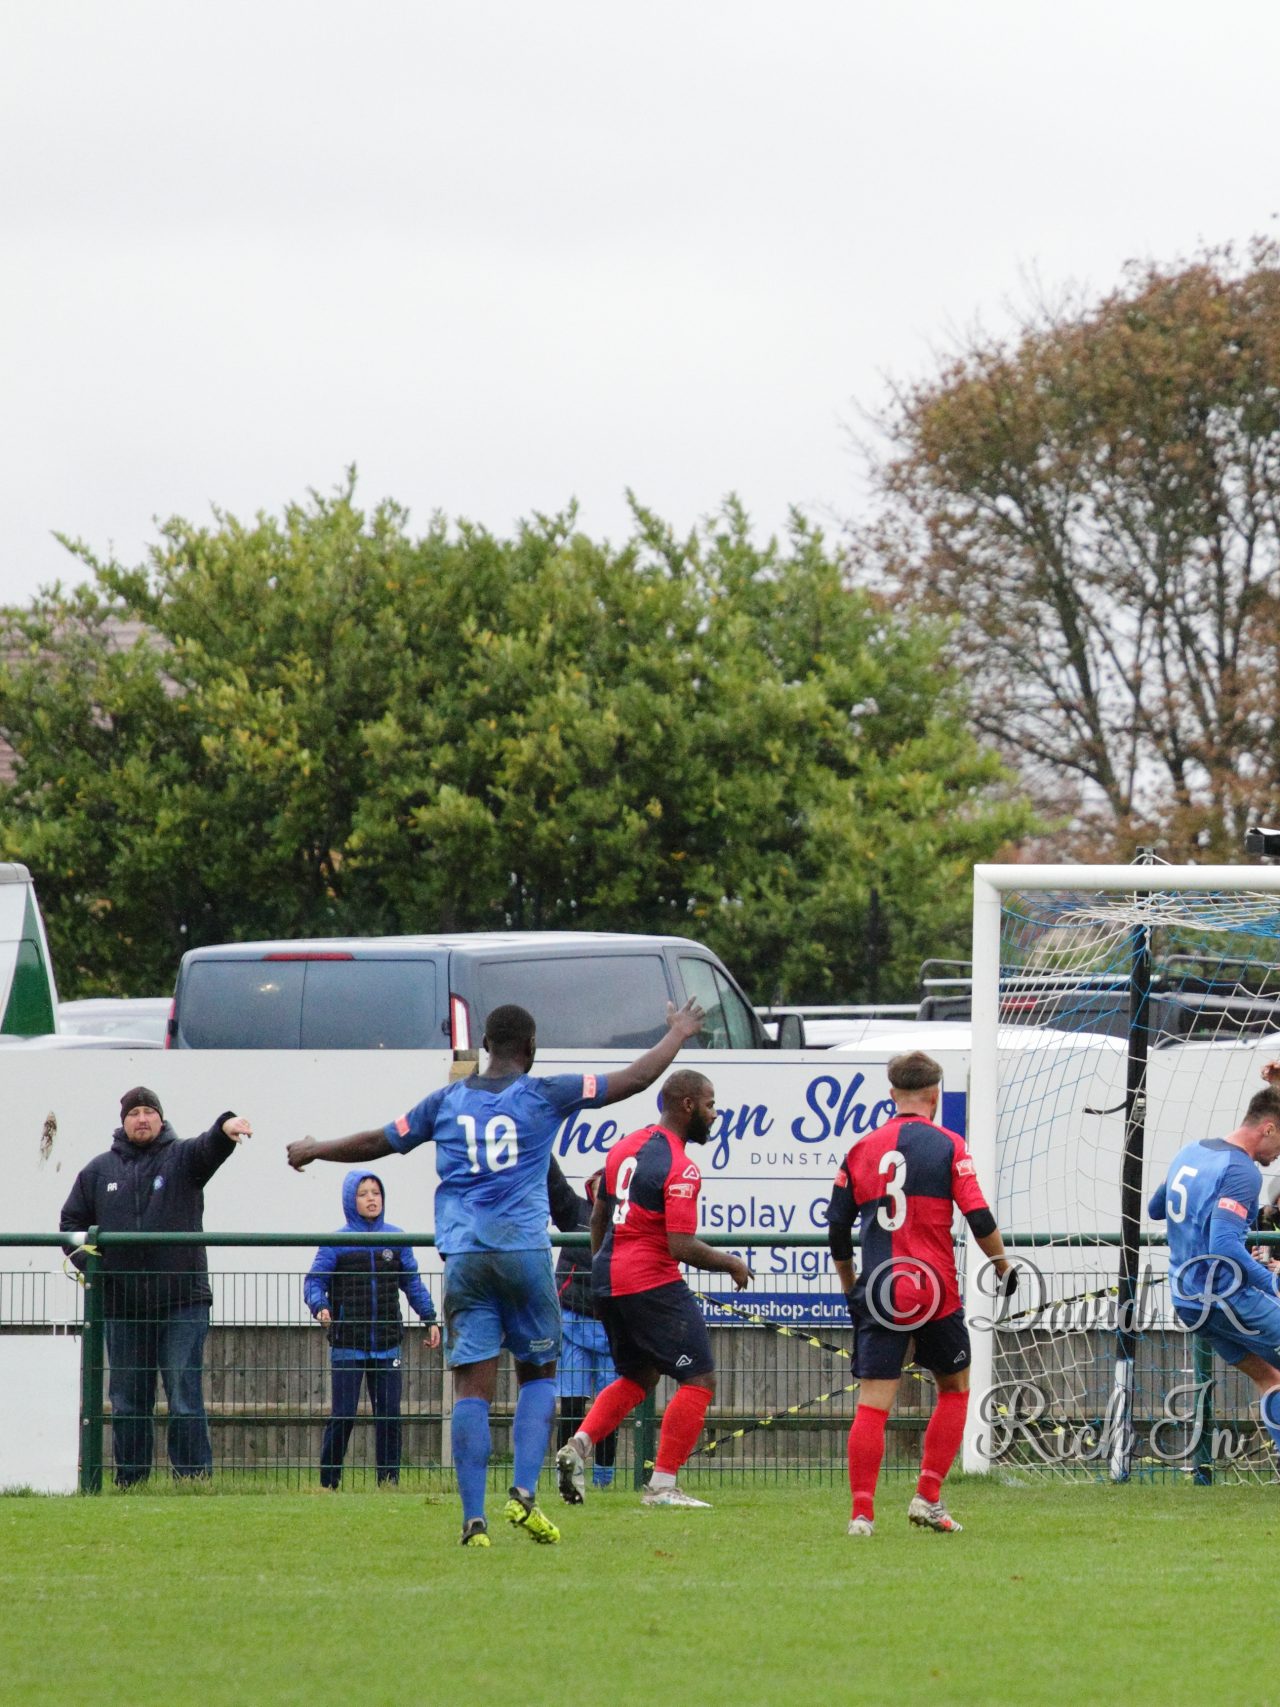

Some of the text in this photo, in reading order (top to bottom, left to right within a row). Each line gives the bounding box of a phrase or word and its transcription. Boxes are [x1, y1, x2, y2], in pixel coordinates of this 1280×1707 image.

[457, 1114, 518, 1173] 10
[558, 1110, 622, 1158] he
[791, 1072, 897, 1143] Sho
[751, 1153, 851, 1166] DUNSTA
[612, 1156, 638, 1225] 9
[701, 1196, 796, 1233] isplay
[876, 1150, 907, 1232] 3
[1167, 1165, 1198, 1223] 5
